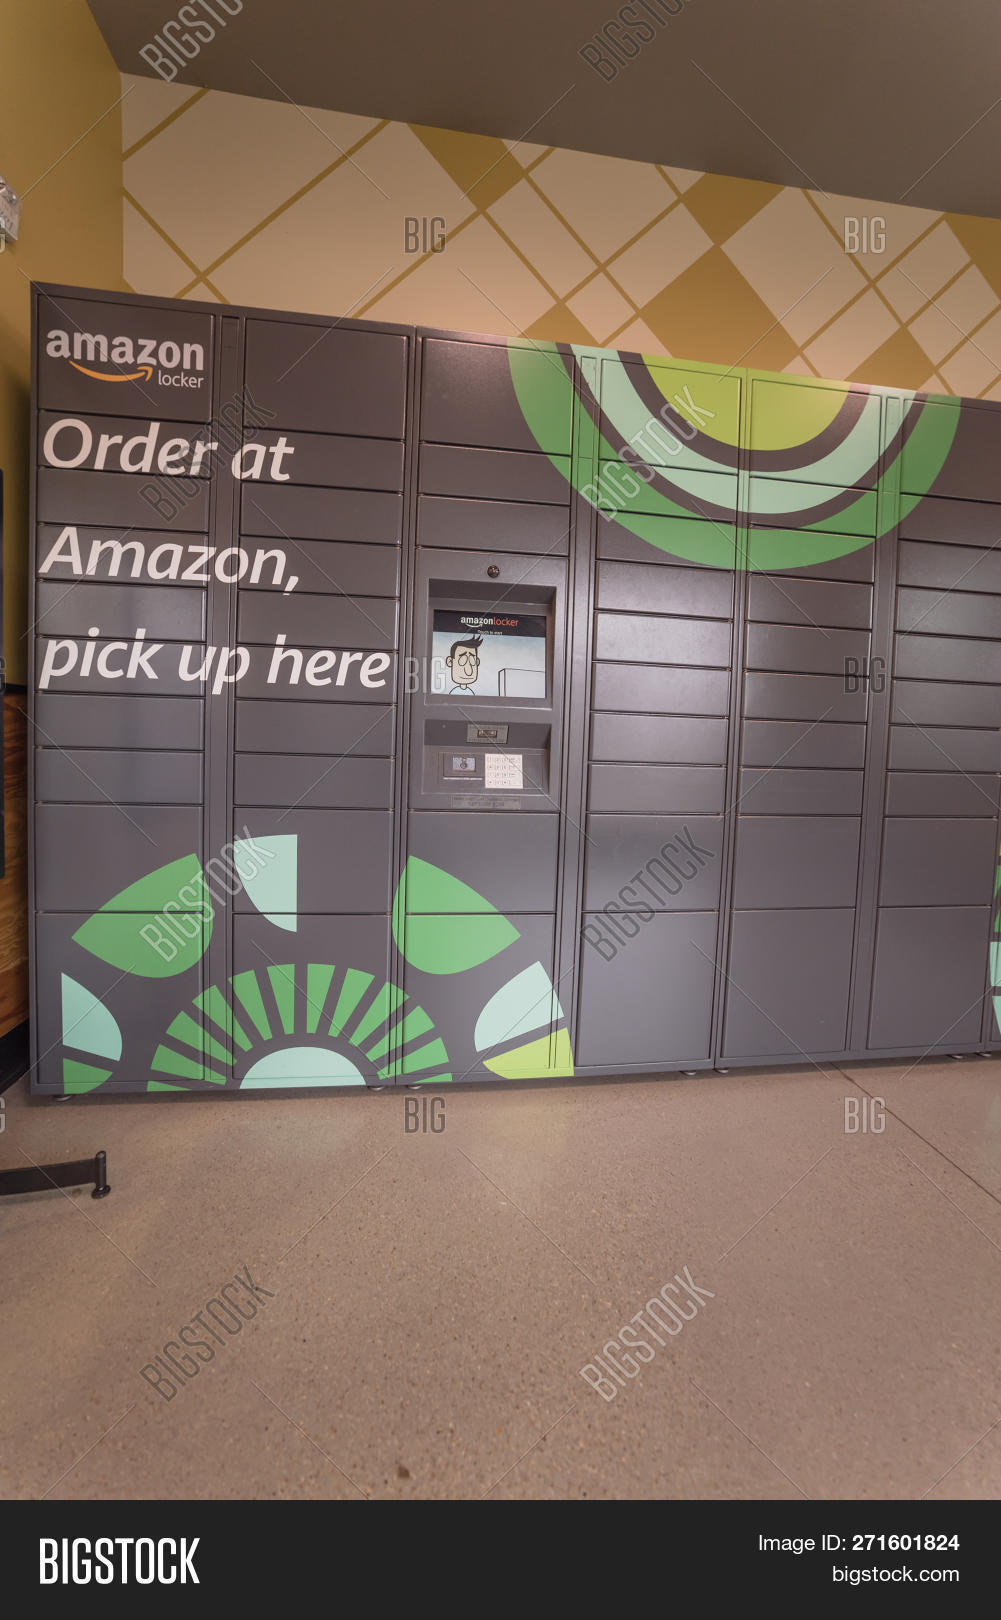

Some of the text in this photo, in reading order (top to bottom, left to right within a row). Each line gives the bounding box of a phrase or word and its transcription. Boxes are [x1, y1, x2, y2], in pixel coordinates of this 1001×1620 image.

[46, 328, 204, 371] amazon
[158, 370, 204, 389] locker
[43, 418, 295, 481] Order at
[38, 526, 299, 596] Amazon,
[38, 626, 164, 690] pick
[178, 647, 250, 695] up
[267, 634, 391, 687] here
